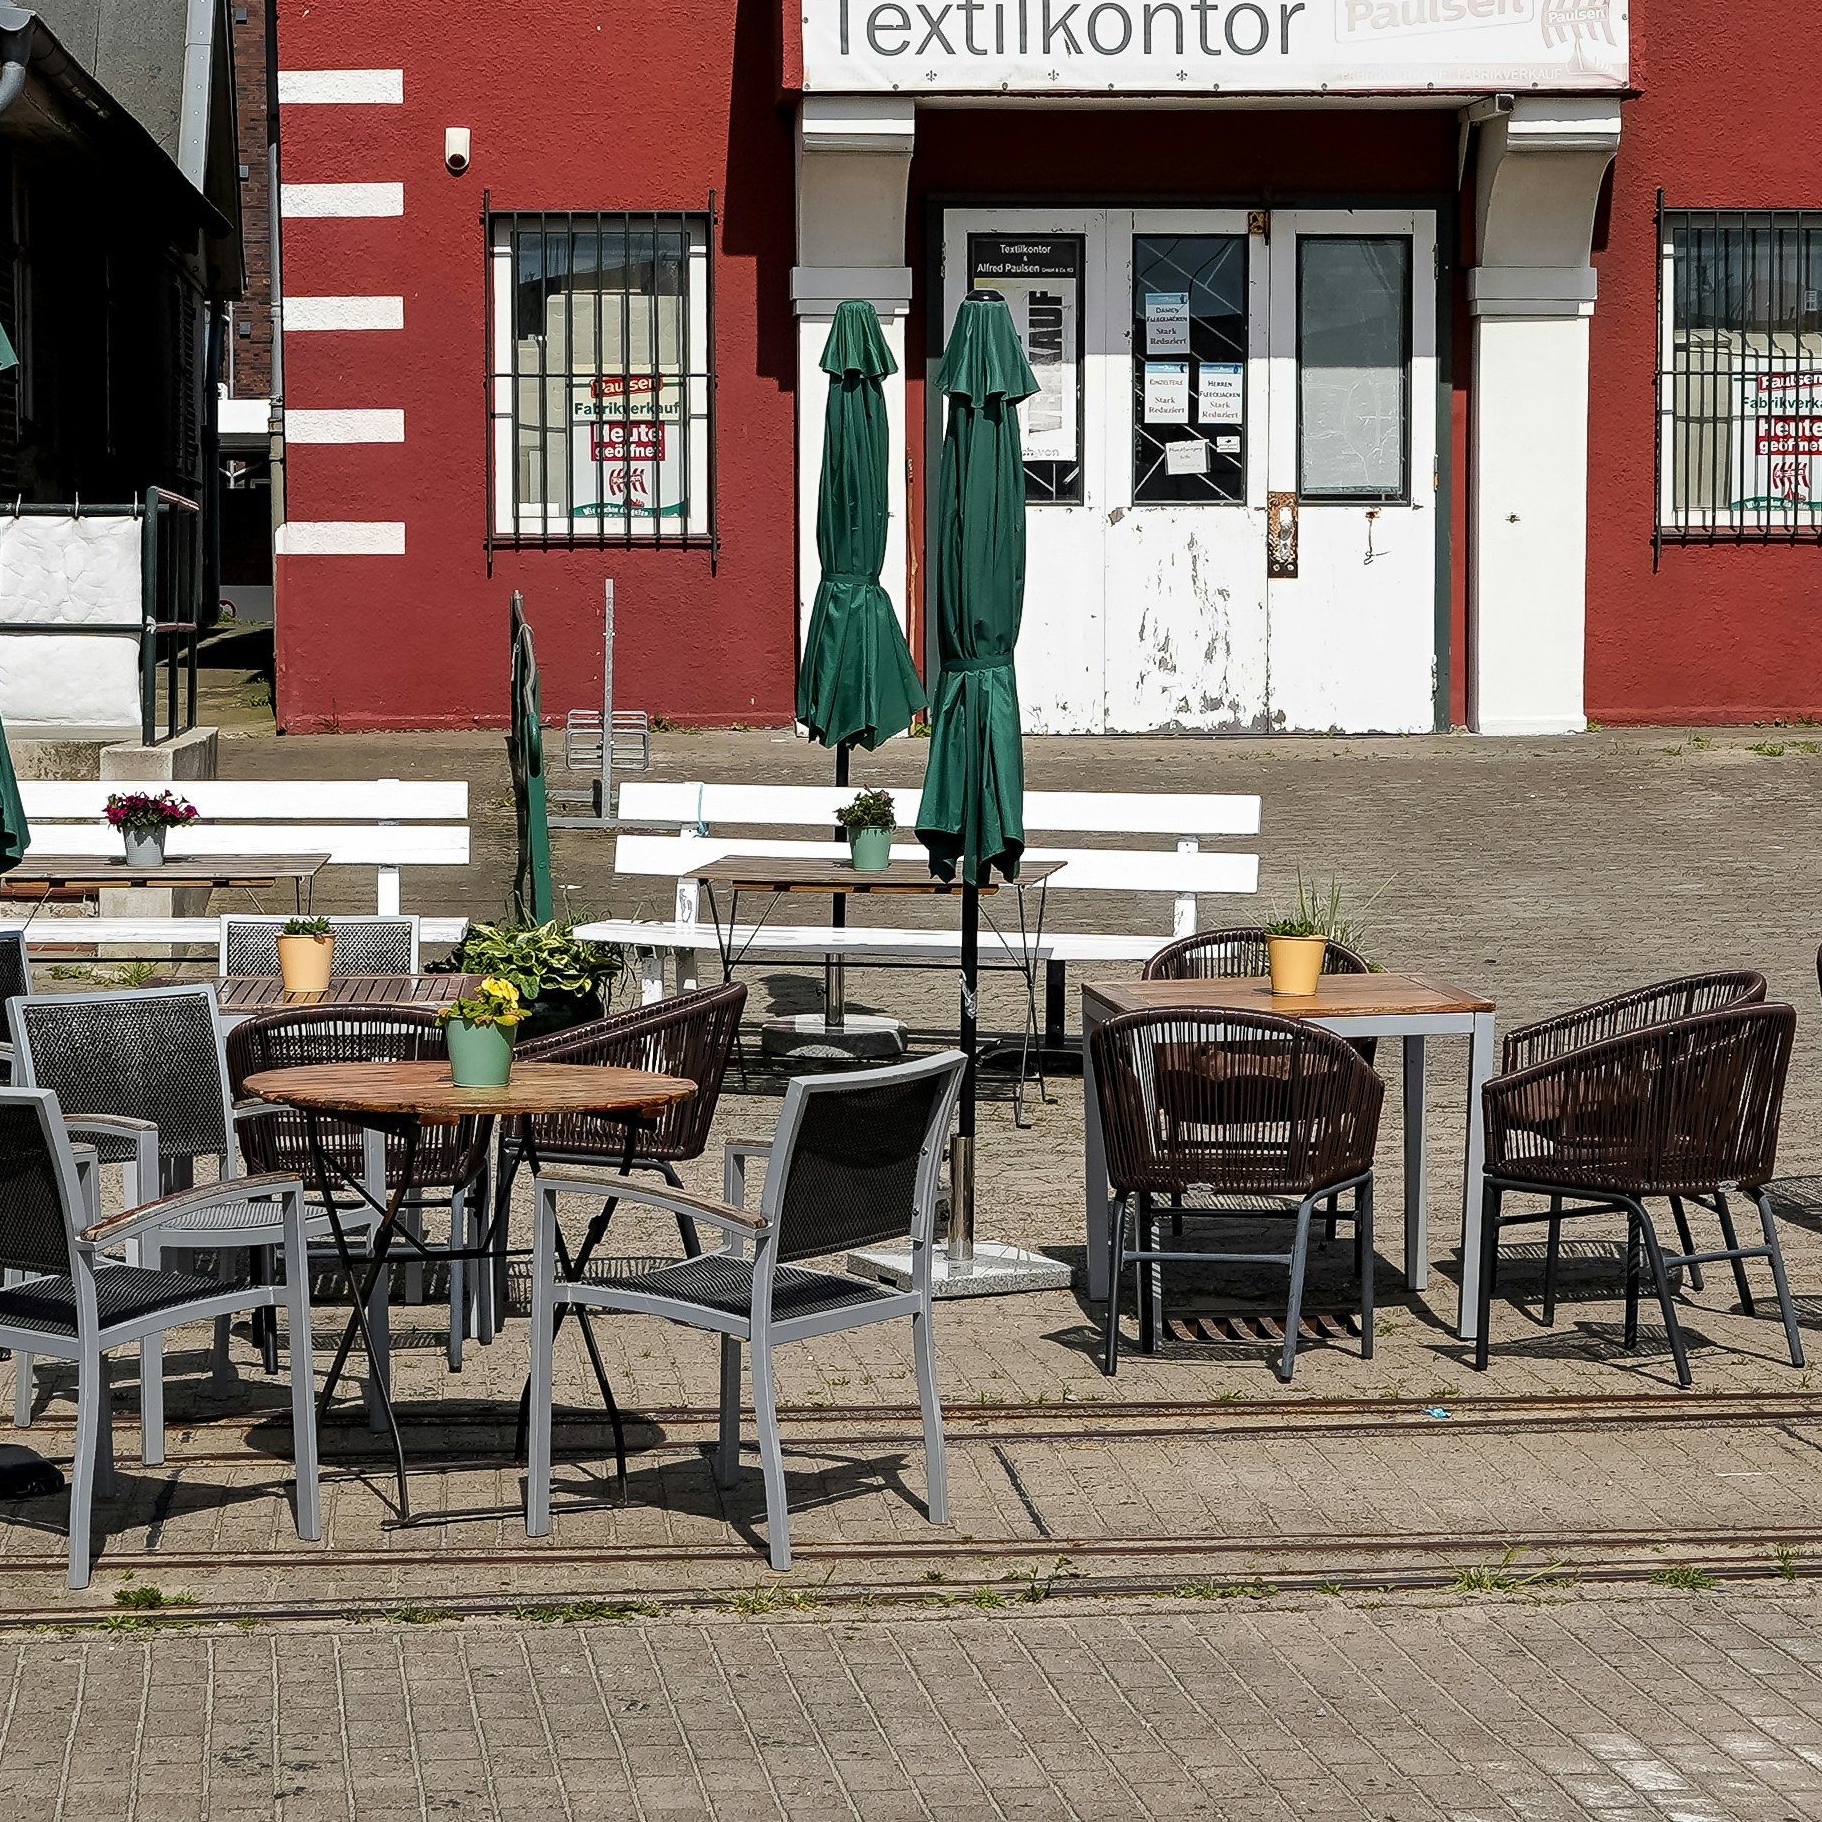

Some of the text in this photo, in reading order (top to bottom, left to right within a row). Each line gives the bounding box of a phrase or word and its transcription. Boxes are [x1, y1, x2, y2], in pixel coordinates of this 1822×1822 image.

[1548, 6, 1606, 24] Paulsen
[1456, 68, 1562, 80] FABRIKVERKAUF
[999, 244, 1052, 254] Textilkontor
[976, 263, 1003, 273] Alfred
[1005, 263, 1040, 273] Paulsen
[574, 402, 680, 415] Fabrikerkauf
